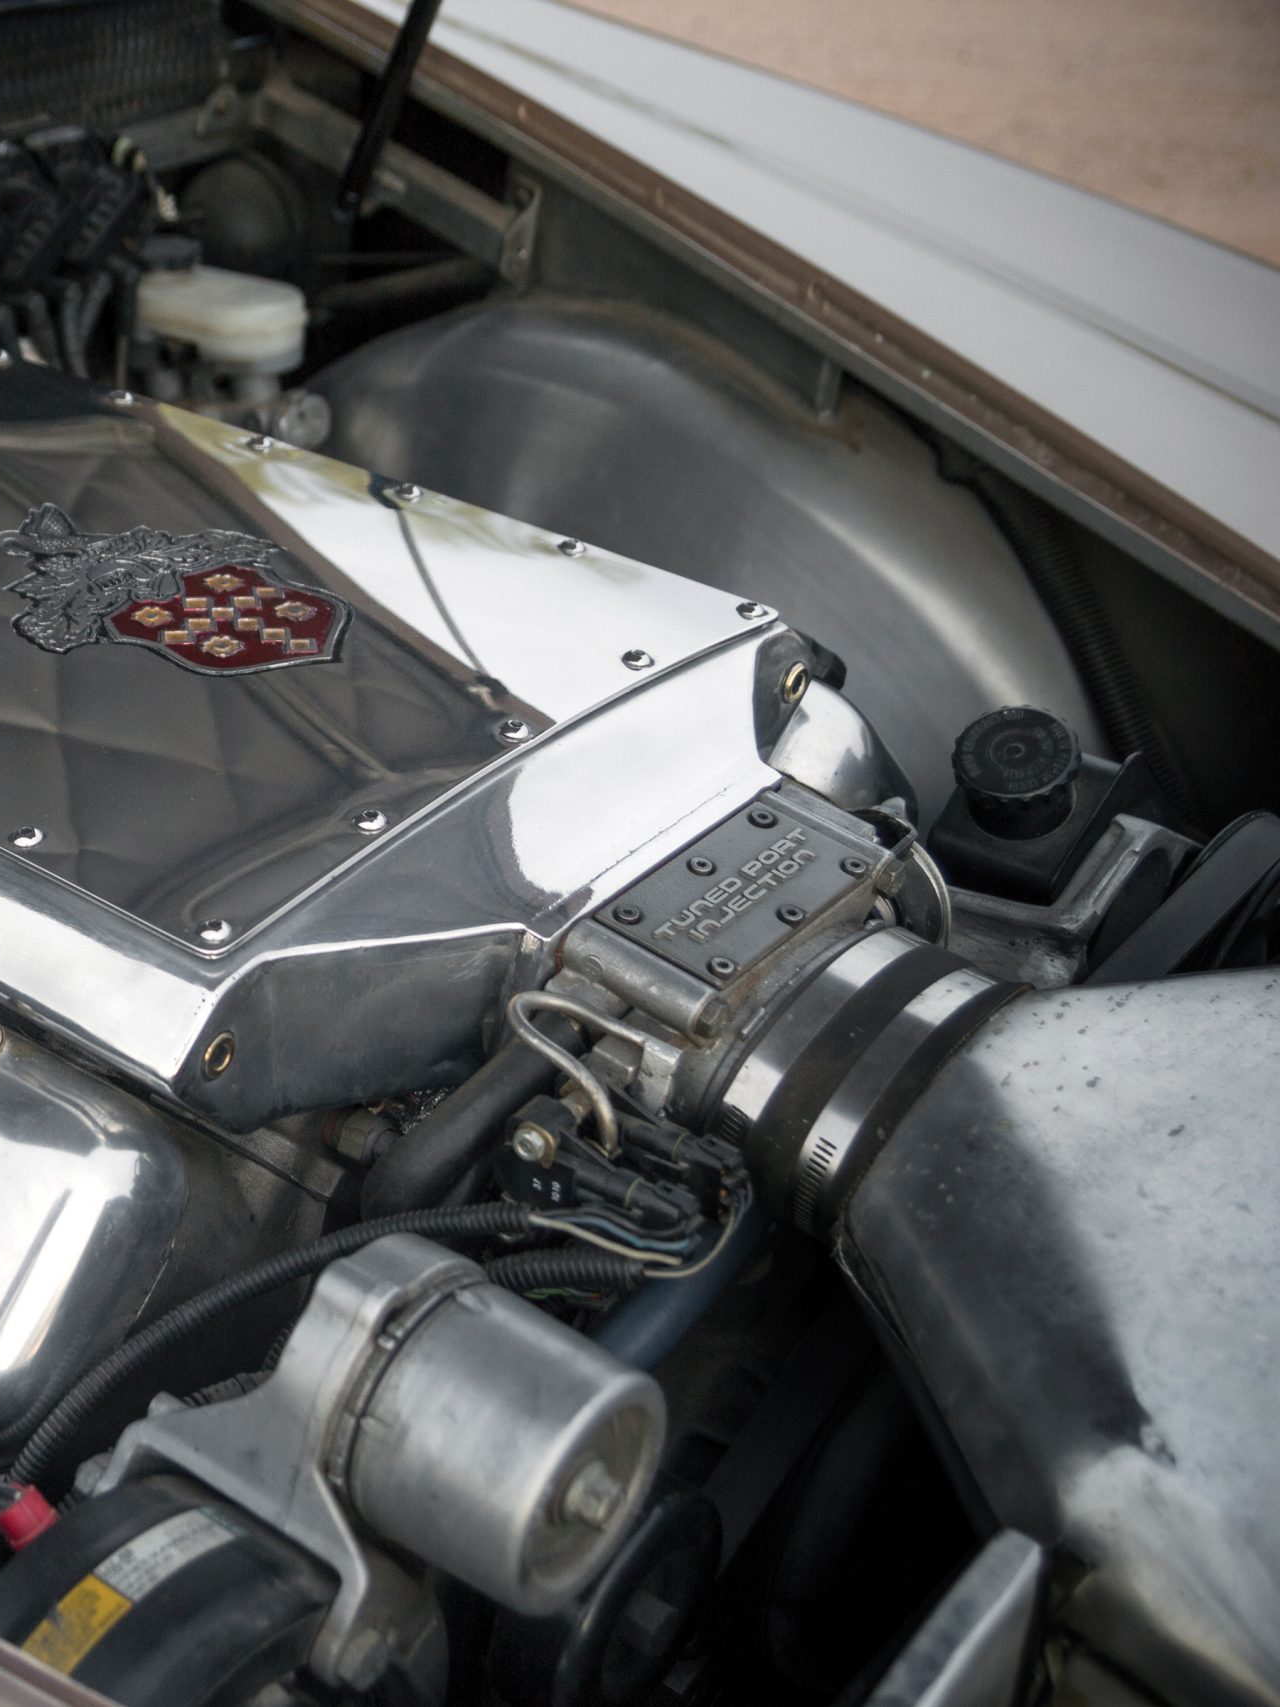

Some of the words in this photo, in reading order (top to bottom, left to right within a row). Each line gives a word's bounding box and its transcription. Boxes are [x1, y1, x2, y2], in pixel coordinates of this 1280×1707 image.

[652, 876, 742, 940] TUNED
[740, 827, 807, 878] PORT
[689, 848, 816, 943] INJECTION
